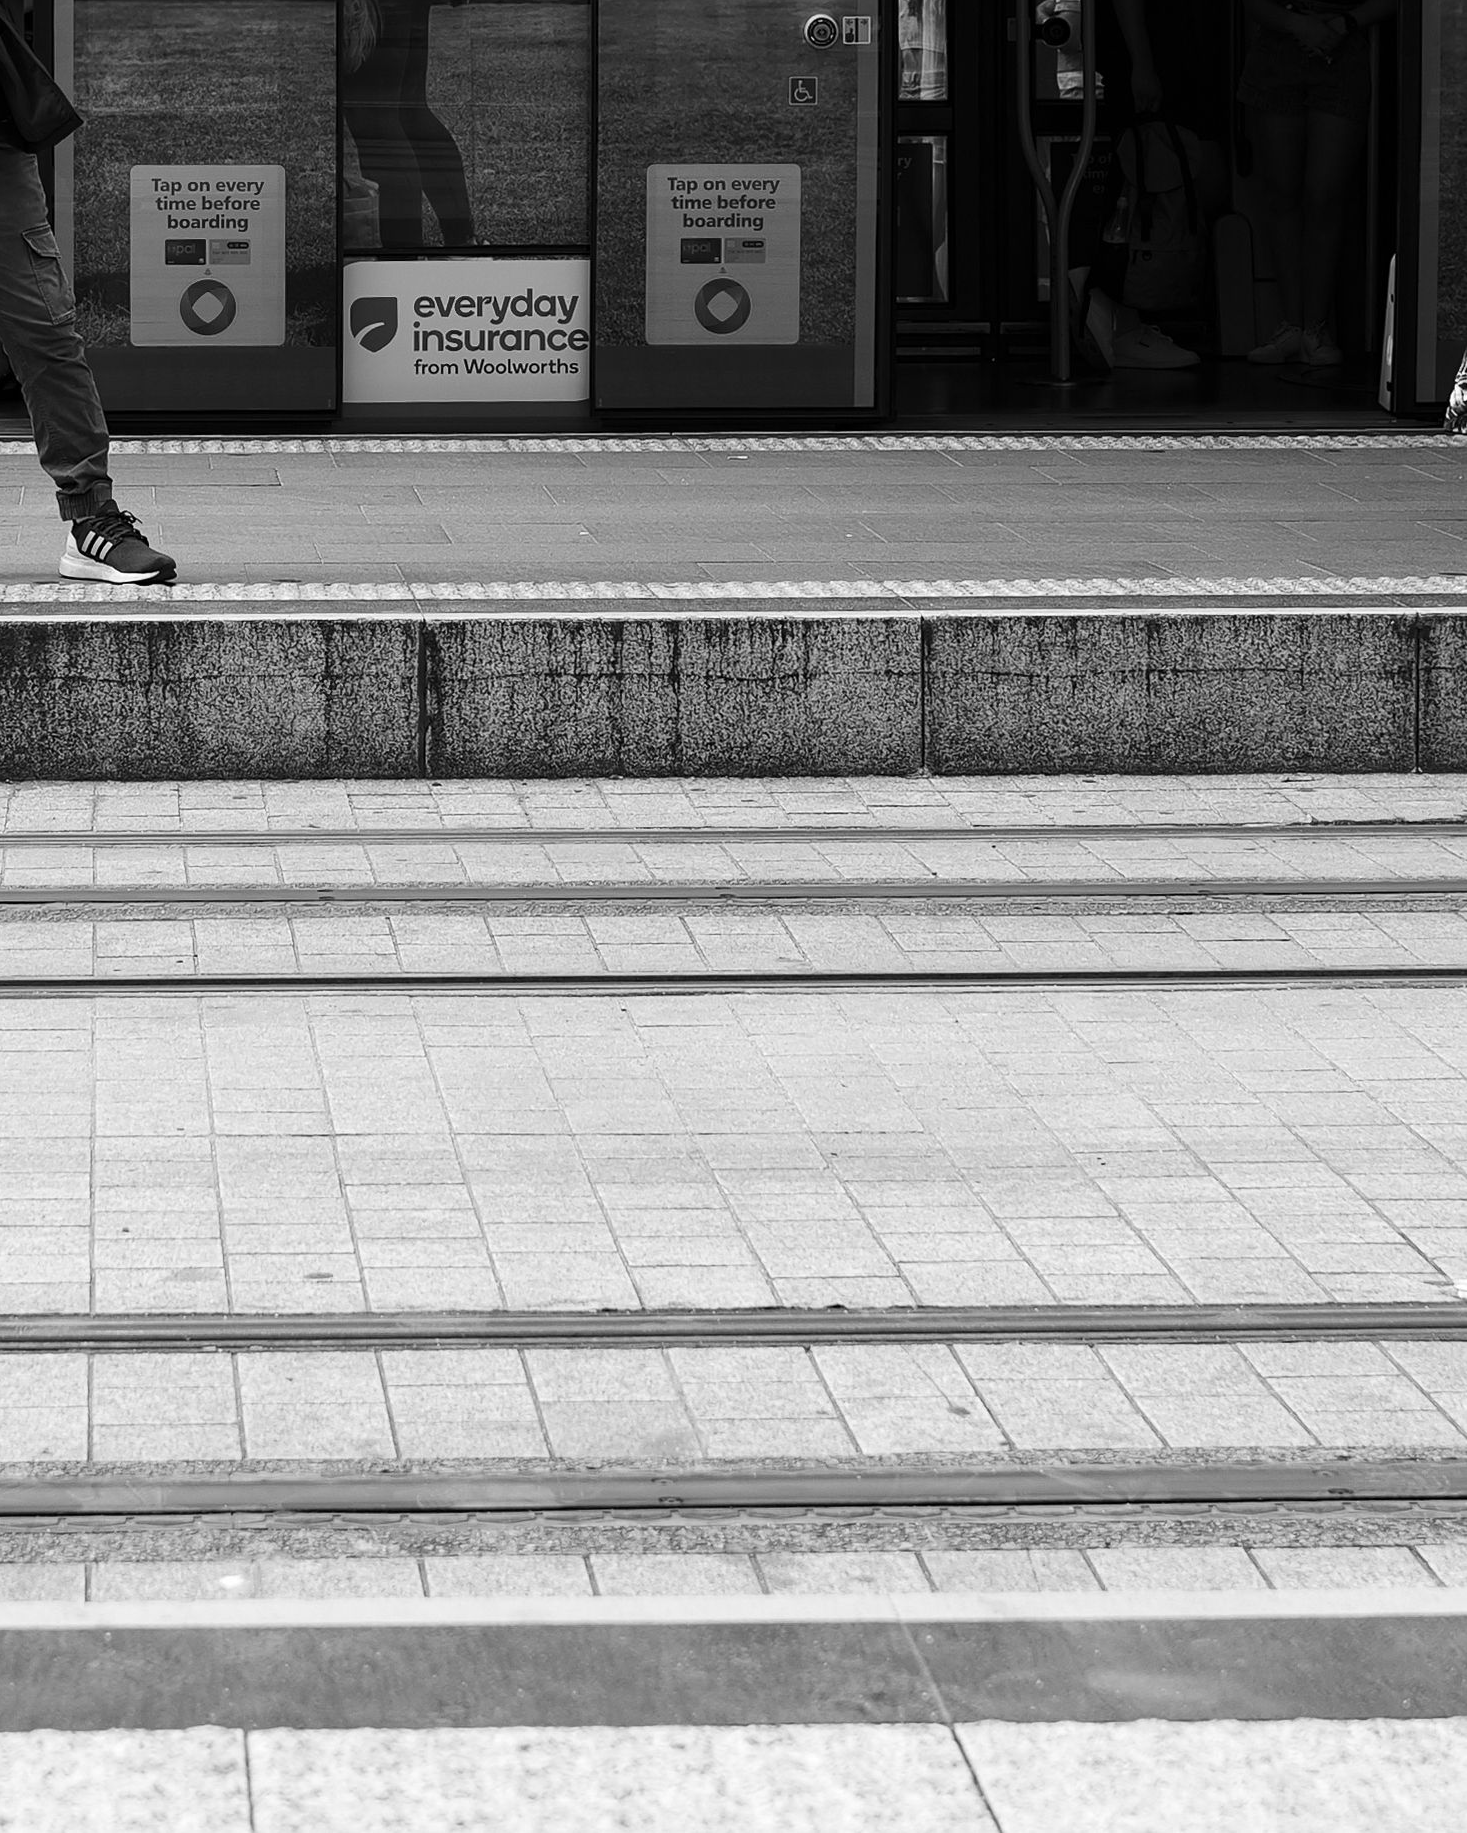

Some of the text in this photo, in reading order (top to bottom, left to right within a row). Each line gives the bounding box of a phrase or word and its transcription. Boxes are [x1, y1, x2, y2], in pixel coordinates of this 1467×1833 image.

[151, 178, 264, 195] Tap on every
[667, 177, 780, 194] Tap on every
[155, 196, 261, 211] time before
[670, 195, 776, 209] time before
[167, 214, 249, 232] boarding
[683, 213, 764, 231] boarding
[413, 288, 579, 325] everyday
[413, 321, 589, 352] insurance
[414, 358, 579, 375] from Woolworths
